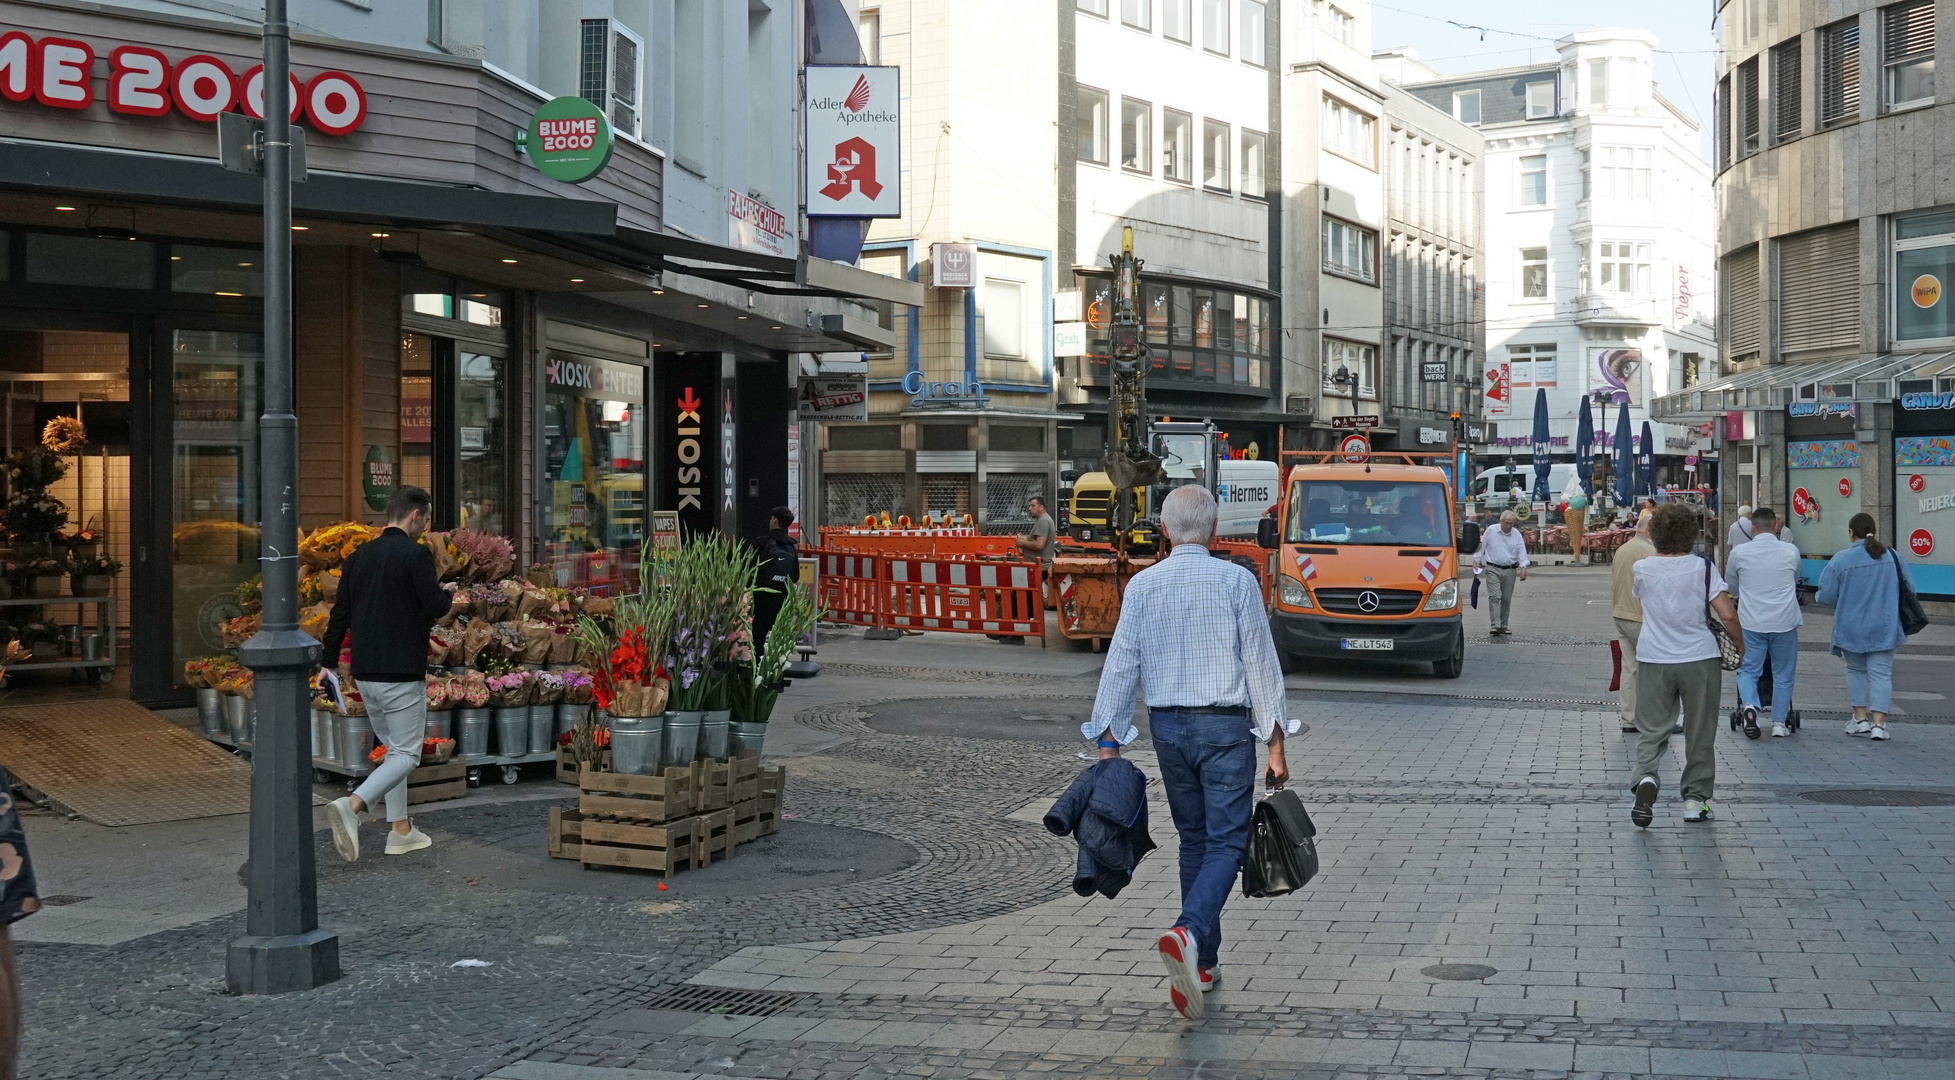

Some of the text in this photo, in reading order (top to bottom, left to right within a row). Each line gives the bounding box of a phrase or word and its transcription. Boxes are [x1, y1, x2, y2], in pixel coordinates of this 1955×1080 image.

[809, 97, 844, 110] Adler
[836, 110, 897, 126] Apotheke
[538, 118, 598, 137] BLUME
[543, 134, 594, 151] 2000
[730, 191, 785, 239] FAHRSCHULE
[1675, 265, 1691, 320] Pieper
[1424, 373, 1446, 381] WERK
[1425, 364, 1444, 374] back
[550, 360, 641, 396] KIOSK CENTER
[902, 371, 990, 408] Grah
[817, 393, 862, 407] RETTIG
[1902, 391, 1954, 409] CANDY
[1496, 434, 1569, 448] PARFÜRIE
[677, 396, 701, 512] KIOSK
[724, 398, 733, 512] KIOSK
[370, 463, 392, 475] BLUME
[372, 475, 392, 486] 2000
[1230, 485, 1269, 502] Hermes
[655, 518, 675, 530] VAPES
[1912, 538, 1930, 547] 50%
[1347, 640, 1358, 648] NE
